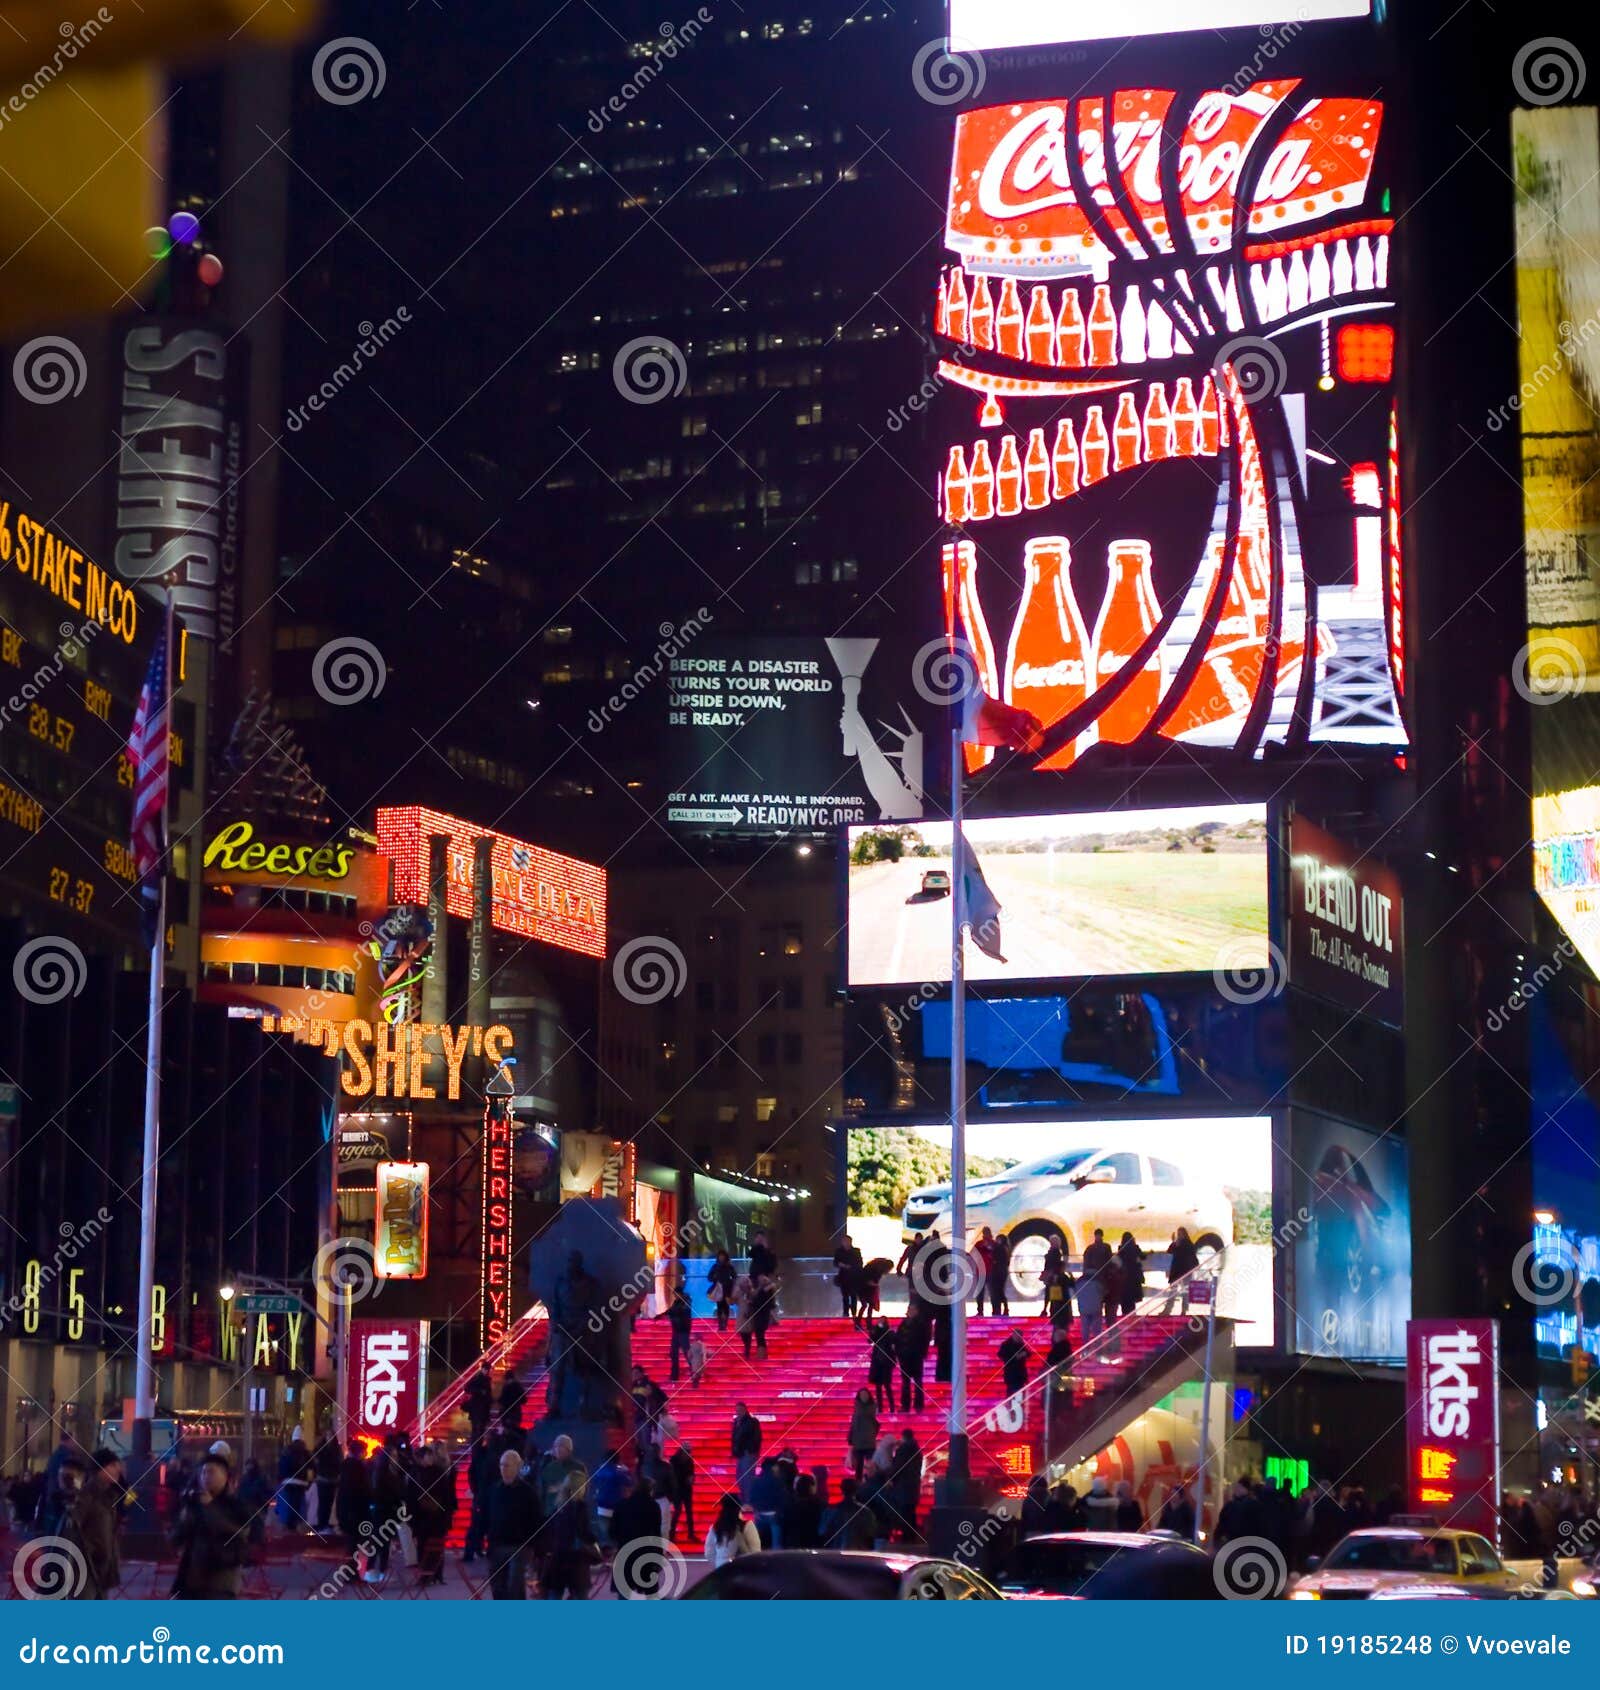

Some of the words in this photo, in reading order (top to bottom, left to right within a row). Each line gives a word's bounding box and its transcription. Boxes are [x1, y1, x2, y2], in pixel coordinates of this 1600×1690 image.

[16, 514, 84, 610] STAKE
[86, 562, 107, 625] IN
[109, 581, 136, 643] CO
[670, 660, 726, 673] BEFORE
[731, 660, 743, 673] A
[749, 661, 819, 674] DISASTER
[670, 677, 720, 690] TURNS
[726, 678, 770, 691] YOUR
[775, 678, 832, 692] WORLD
[670, 695, 723, 708] UPSIDE
[729, 695, 786, 711] DOWN,
[670, 713, 687, 725] BE
[692, 713, 745, 726] READY.
[29, 702, 75, 753] 28.57
[668, 794, 687, 802] GET
[689, 794, 697, 802] A
[700, 794, 717, 803] KIT.
[721, 794, 749, 803] MAKE
[752, 795, 760, 803] A
[763, 795, 792, 804] PLAN.
[796, 796, 807, 804] BE
[810, 796, 865, 805] INFORMED.
[671, 811, 688, 819] CALL
[747, 807, 865, 826] READYNYC.ORG
[204, 821, 354, 878] Reese's
[50, 867, 94, 914] 27.37
[1304, 855, 1357, 932] BLEND
[1310, 928, 1326, 959] The
[1328, 936, 1361, 976] All-New
[1362, 953, 1389, 989] Sonata
[259, 1299, 274, 1309] 47
[365, 1330, 409, 1427] tkts
[1429, 1330, 1481, 1438] tkts
